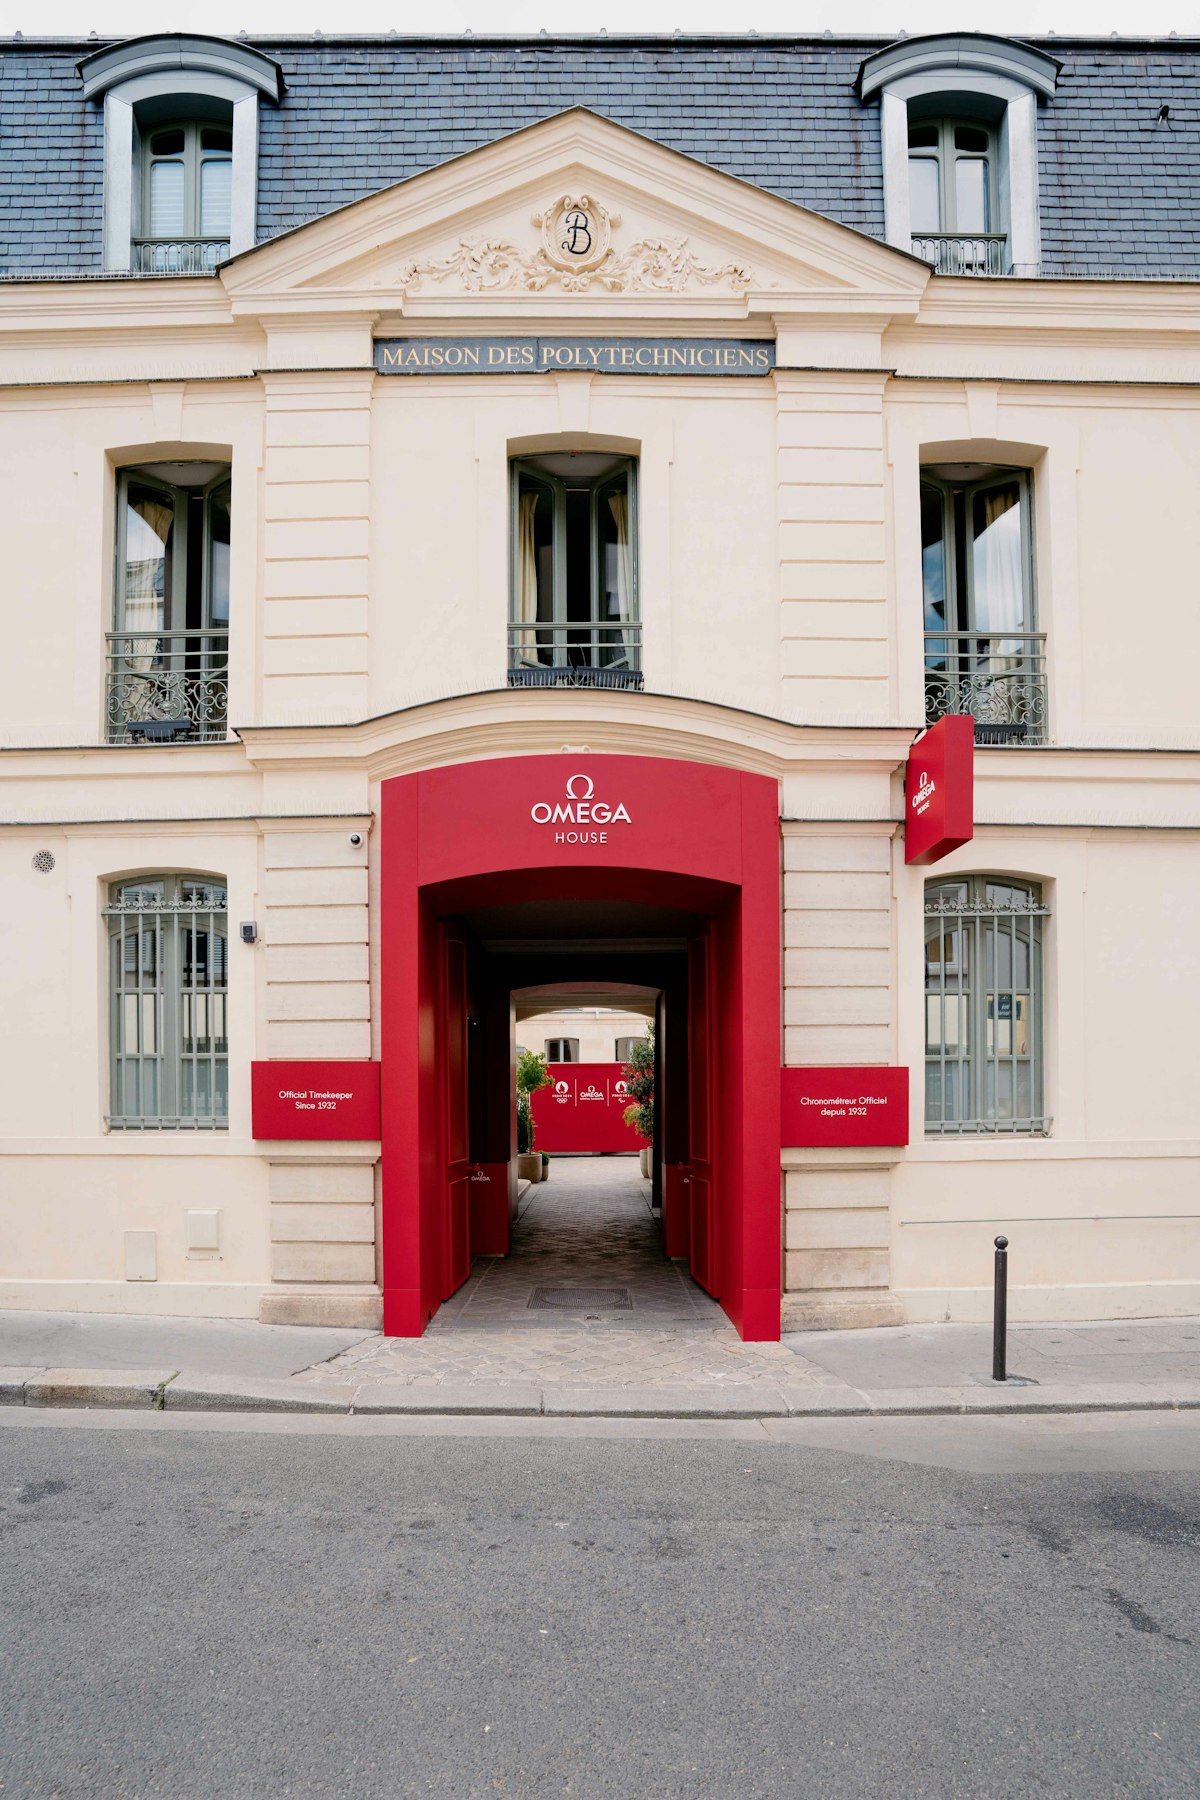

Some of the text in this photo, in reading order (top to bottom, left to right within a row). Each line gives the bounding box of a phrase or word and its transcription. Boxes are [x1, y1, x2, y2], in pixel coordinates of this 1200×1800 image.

[383, 346, 769, 367] MAISON DES POLYTECHNICIENS
[912, 780, 936, 808] OMEGA
[530, 802, 632, 824] OMEGA
[555, 832, 608, 844] HOUSE
[278, 1090, 353, 1101] Official Timekeeper
[800, 1096, 888, 1106] Chronométreur Officiel
[295, 1101, 337, 1110] Since 1932
[820, 1107, 867, 1117] depuis 1932
